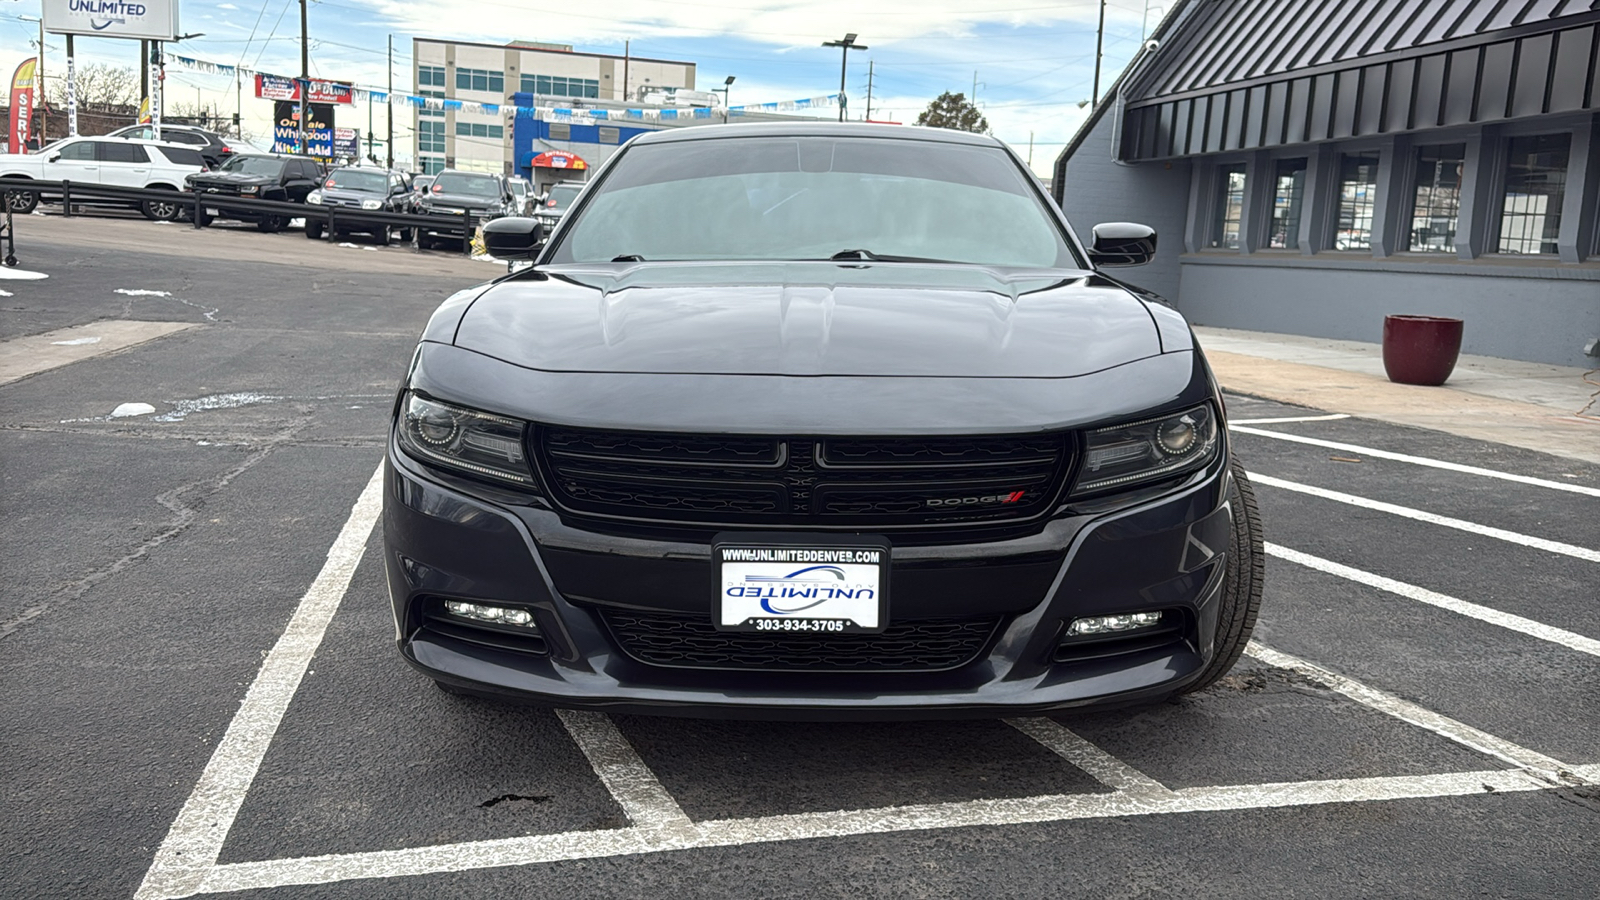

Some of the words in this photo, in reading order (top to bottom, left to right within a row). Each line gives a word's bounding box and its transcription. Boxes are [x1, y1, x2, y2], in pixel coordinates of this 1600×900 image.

[69, 0, 146, 16] UNLIMITED
[280, 118, 297, 128] On
[307, 121, 326, 129] ale
[275, 127, 331, 141] Whiool
[275, 141, 331, 156] KitcnAid
[926, 495, 1012, 506] DODGE
[722, 549, 879, 563] WWWUNLIMITEDDENVER.COM
[726, 586, 874, 600] UNLIMITED
[756, 619, 843, 632] 303-934-3705
